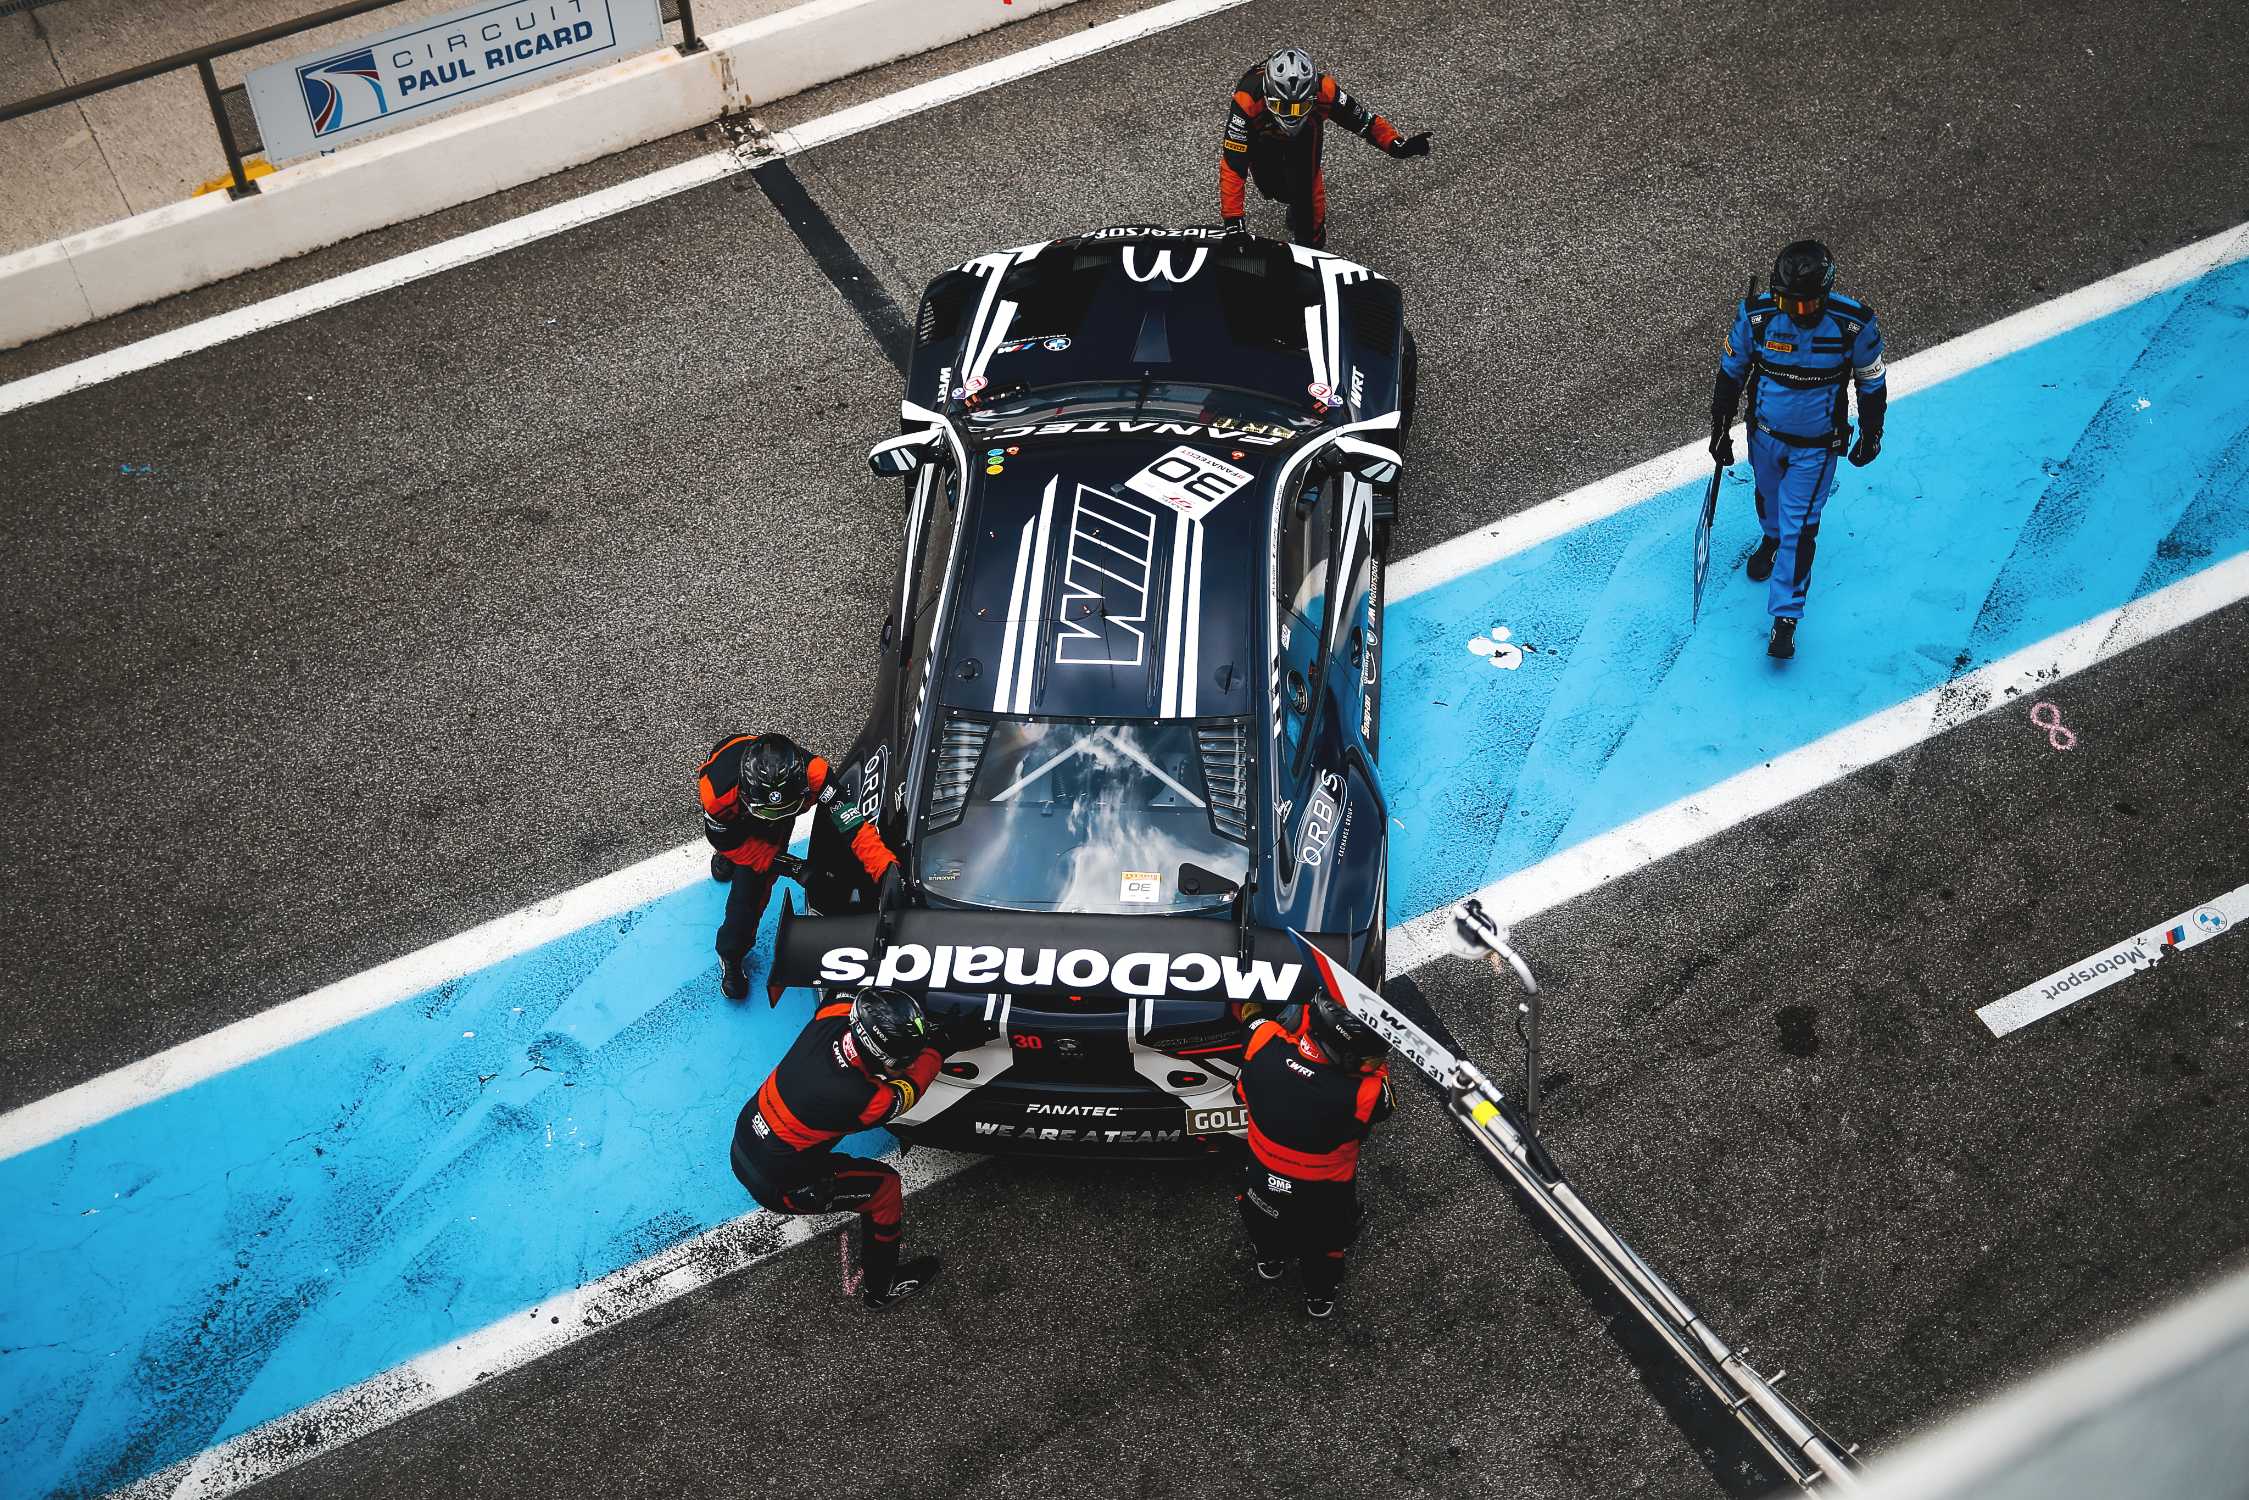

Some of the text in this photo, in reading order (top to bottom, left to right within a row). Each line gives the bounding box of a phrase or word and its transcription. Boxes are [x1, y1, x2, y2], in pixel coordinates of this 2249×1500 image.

[392, 0, 583, 69] CIRCUIT
[398, 20, 593, 97] PAUL RICARD
[938, 366, 952, 403] WRT
[1350, 364, 1365, 409] WRT
[985, 421, 1283, 446] FANATEC
[1147, 457, 1238, 503] 30
[819, 785, 835, 803] OMP
[862, 755, 880, 825] ORBI
[1302, 768, 1338, 867] ORBIS
[820, 944, 1302, 1000] McDonald's
[2041, 946, 2146, 1000] Motorsport
[872, 1025, 888, 1042] uvex
[1013, 1035, 1043, 1049] 30
[1357, 1009, 1444, 1083] 30 32 46 31
[1379, 1009, 1442, 1057] WRT
[833, 1046, 849, 1068] WRT
[1290, 1061, 1316, 1078] WRT
[753, 1114, 770, 1137] OMP
[1026, 1103, 1121, 1117] FANATEC
[975, 1121, 1181, 1144] WE ARE A TEAM
[1267, 1176, 1292, 1191] OMP
